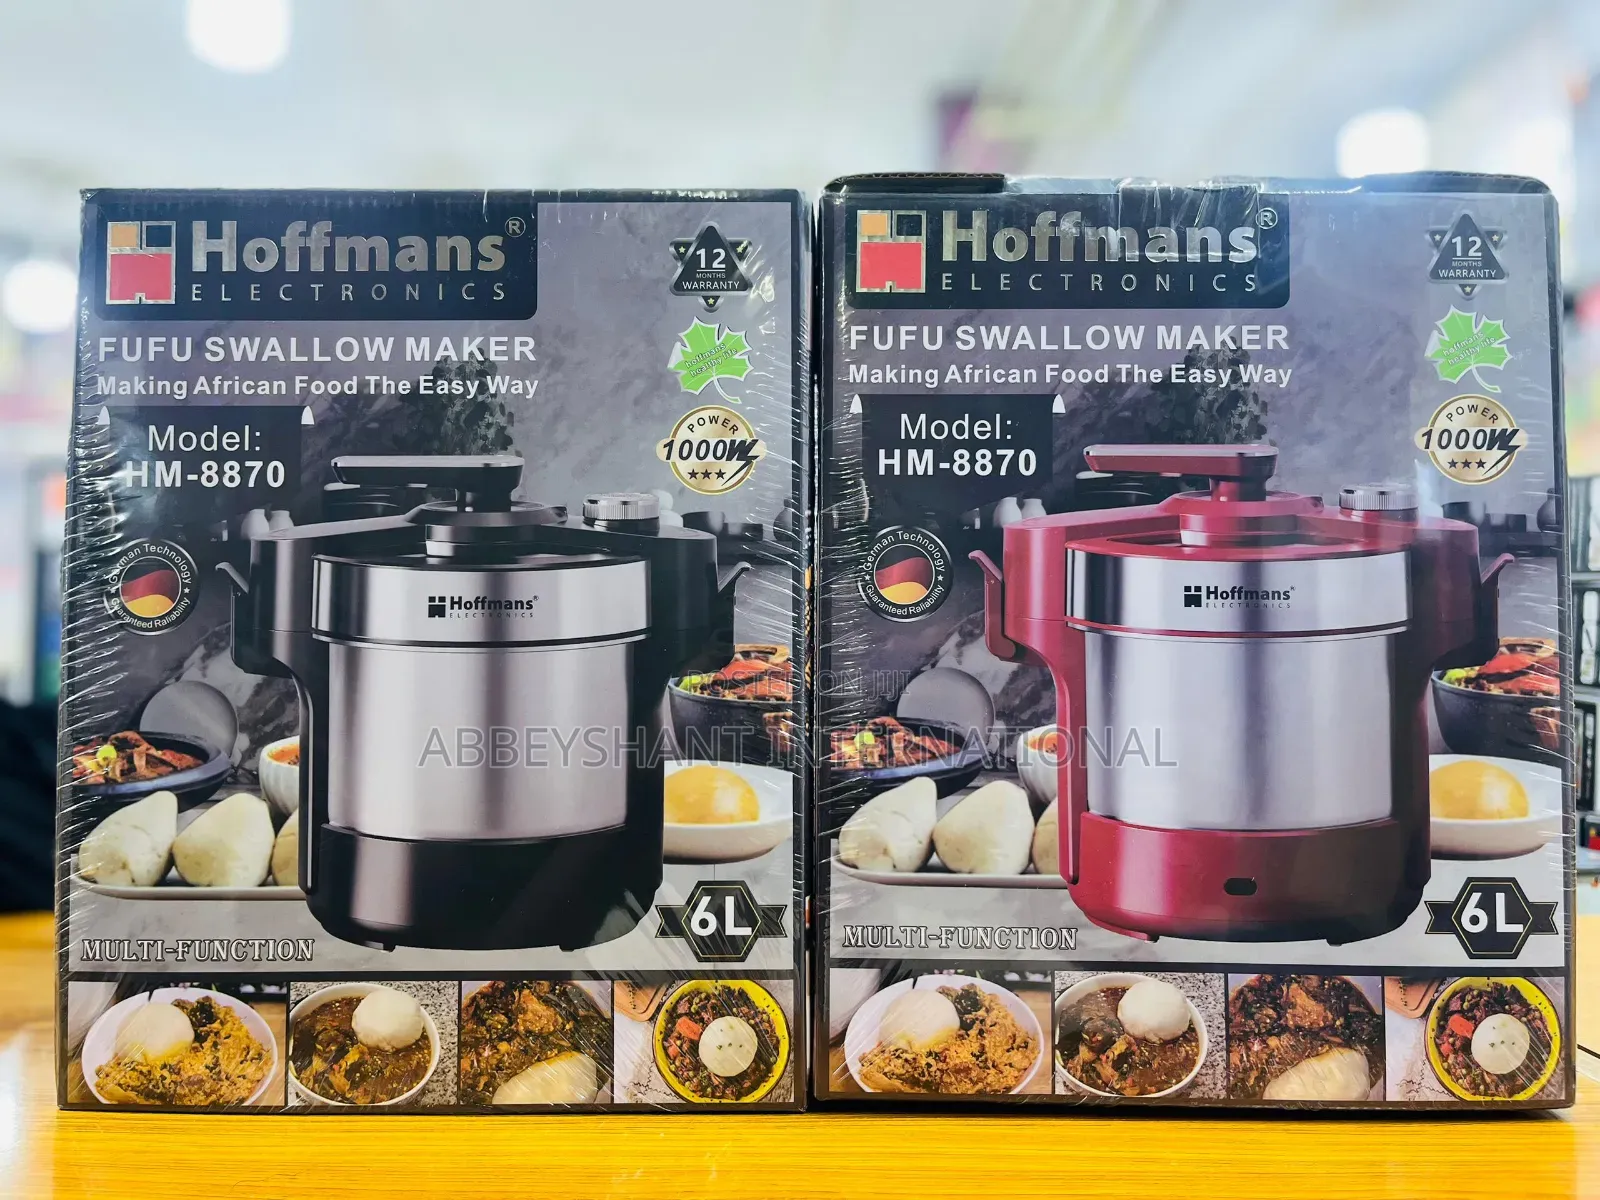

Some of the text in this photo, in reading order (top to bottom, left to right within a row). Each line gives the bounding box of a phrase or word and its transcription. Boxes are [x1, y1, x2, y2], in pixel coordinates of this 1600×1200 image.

[696, 248, 726, 269] 12
[1451, 236, 1482, 257] 12
[682, 281, 740, 290] WARRANTY
[942, 273, 1256, 292] ELECTRONICS
[1438, 269, 1496, 278] WARRANTY
[191, 283, 505, 301] ELECTRONICS
[98, 336, 537, 363] FUFU SWALLOW MAKER
[849, 325, 1289, 351] FUFU SWALLOW MAKER
[96, 375, 539, 399] Making African Food The Easy Way
[849, 364, 1292, 388] Making African Food The Easy Way
[687, 415, 739, 435] POWER
[900, 413, 1013, 440] Model:
[1446, 404, 1499, 424] POWER
[147, 425, 261, 452] Model:
[1421, 428, 1521, 461] 1000W
[663, 438, 760, 470] 1000W
[878, 449, 1037, 476] HM-8870
[125, 460, 286, 488] HM-8870
[143, 543, 192, 584] Technology
[862, 530, 945, 572] German Technology
[866, 584, 907, 615] Guaranteed
[691, 895, 752, 936] 6L
[1461, 892, 1523, 933] 6L
[81, 938, 315, 962] MULTI-FUNCTION
[842, 925, 1078, 950] MULTI-FUNCTION
